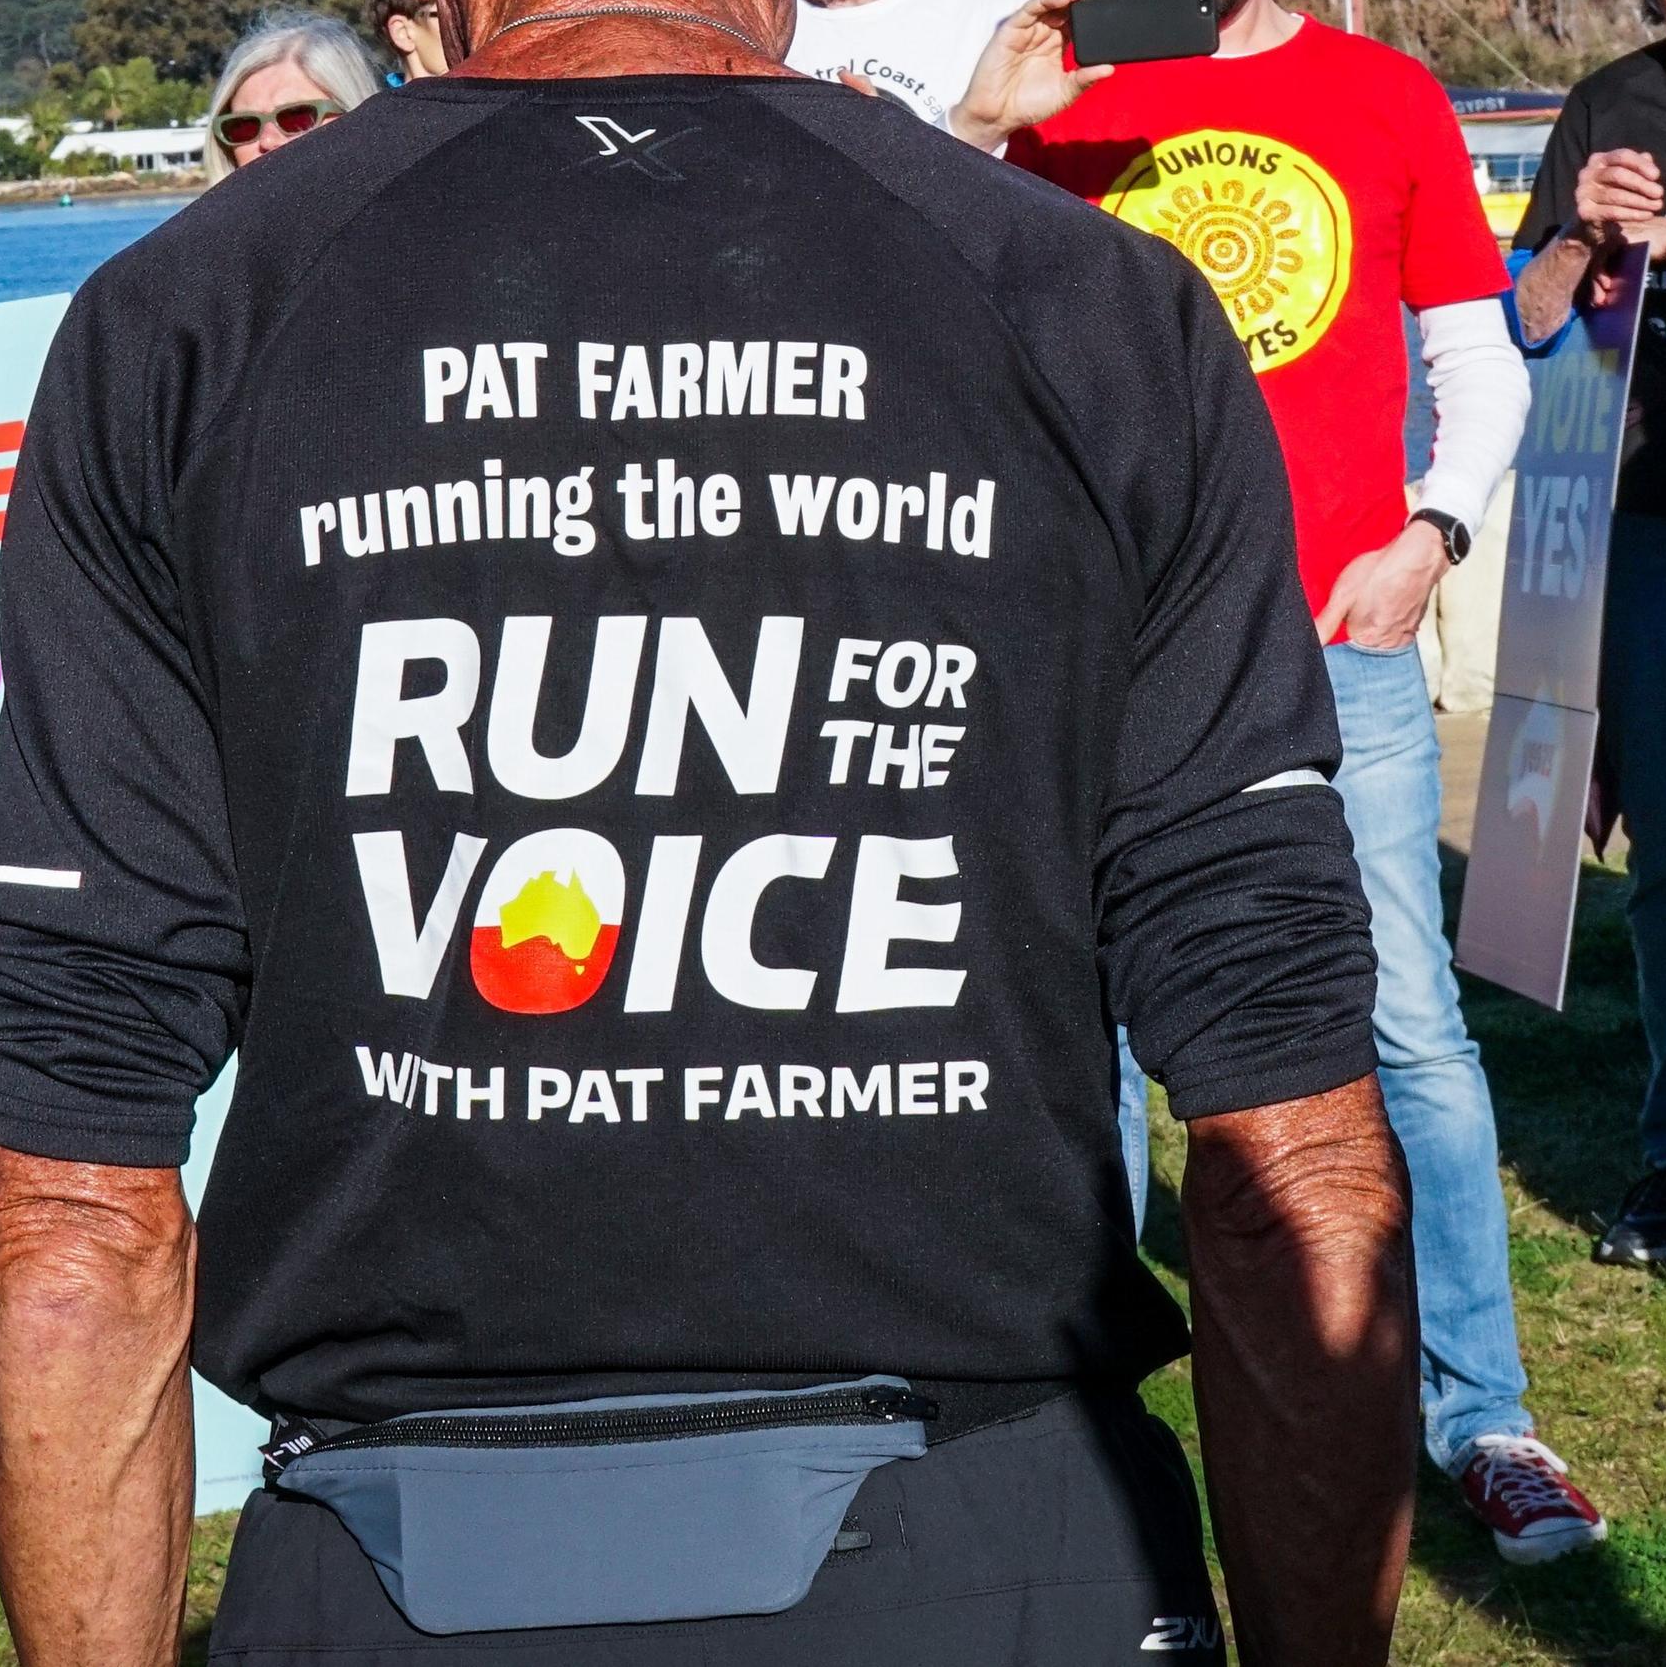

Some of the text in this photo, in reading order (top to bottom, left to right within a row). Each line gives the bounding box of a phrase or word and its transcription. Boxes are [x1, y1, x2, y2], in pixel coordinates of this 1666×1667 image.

[863, 58, 926, 96] Coast
[923, 95, 944, 117] sa
[1157, 140, 1282, 176] UNIONS
[1240, 319, 1299, 362] YES
[424, 341, 868, 423] PAT FARMER
[1536, 349, 1620, 454] VOTE
[300, 459, 995, 566] running the world
[345, 616, 977, 800] RUN FOR
[820, 720, 966, 789] THE
[352, 828, 967, 1014] VOICE
[355, 1046, 989, 1123] WITH PAT FARMER
[1140, 1617, 1219, 1650] 2XU
